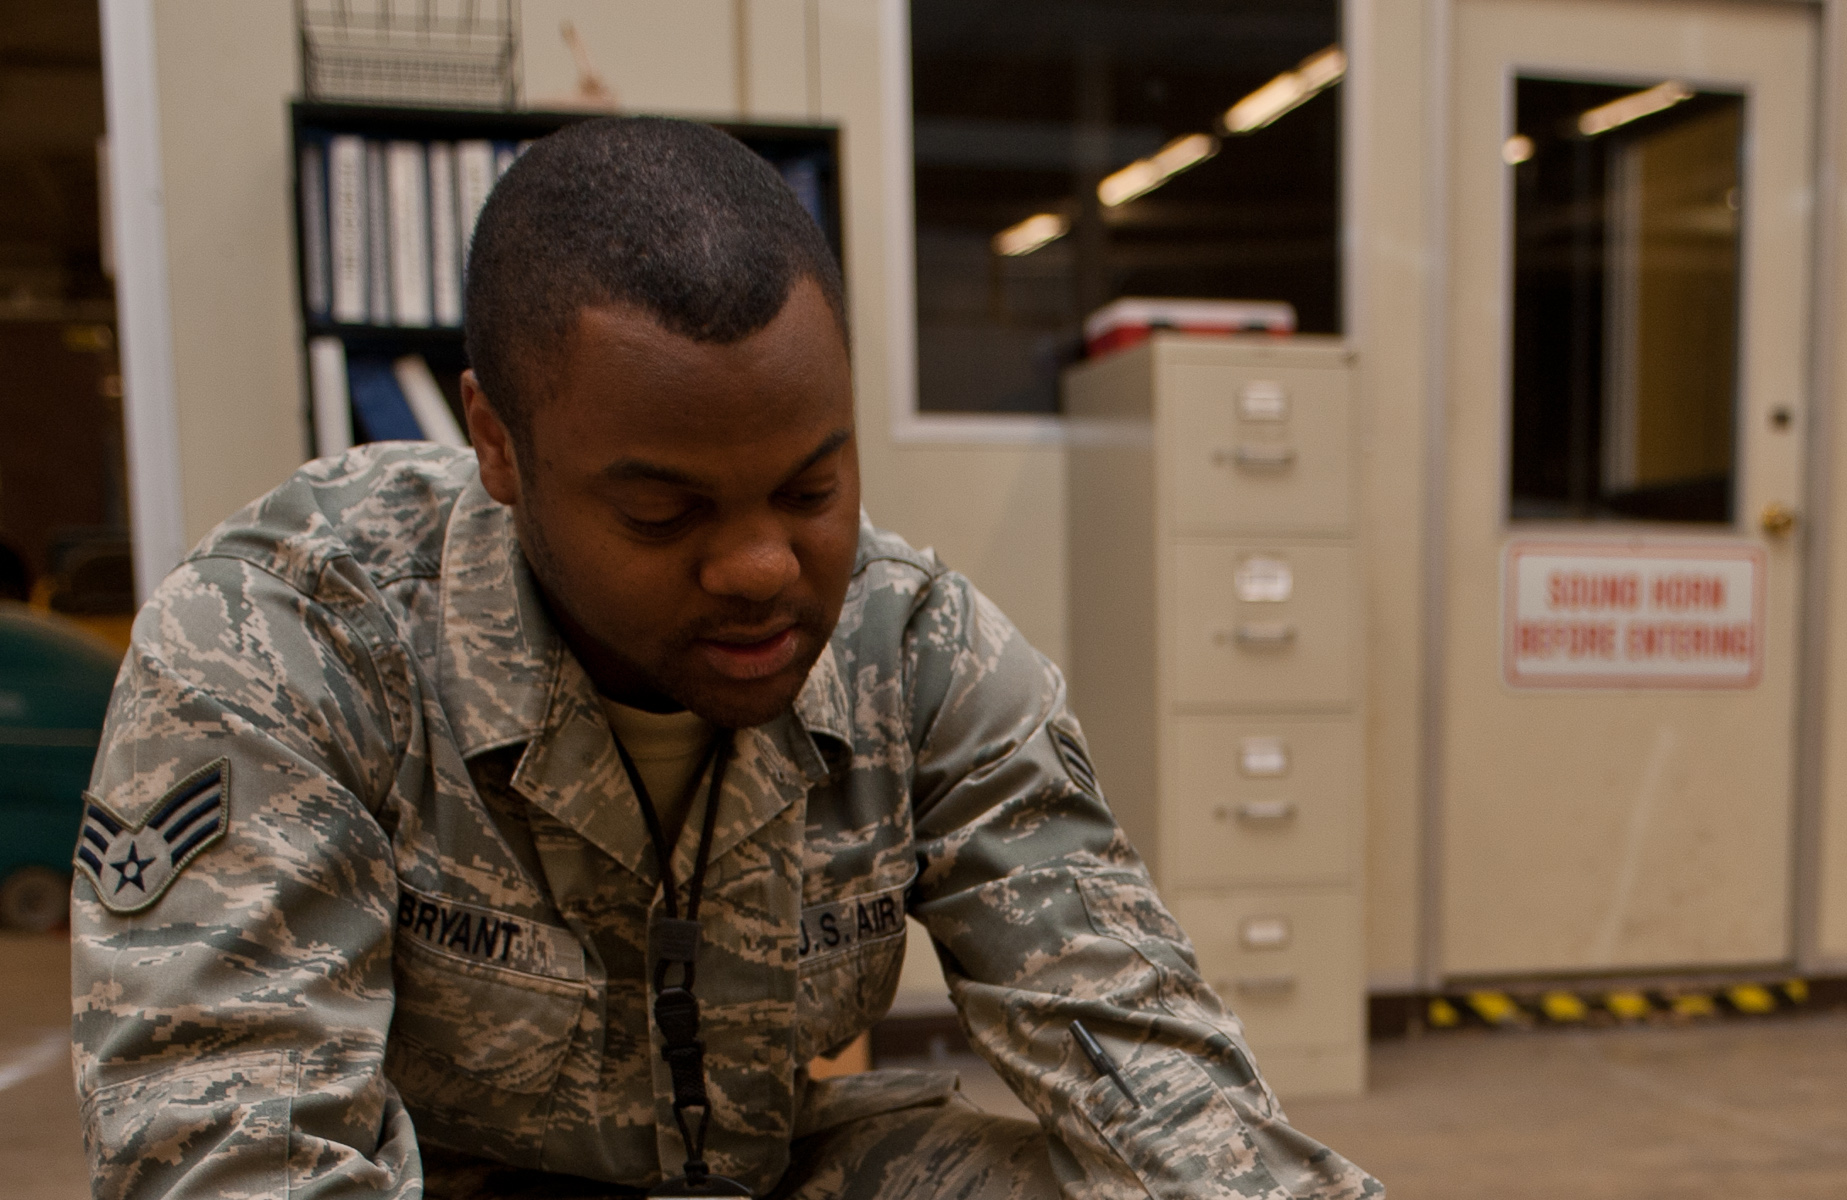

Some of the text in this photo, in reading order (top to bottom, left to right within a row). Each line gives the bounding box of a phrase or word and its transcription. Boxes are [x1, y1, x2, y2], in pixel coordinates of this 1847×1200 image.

[1550, 573, 1724, 610] SOUND HORN
[1517, 621, 1749, 661] BEFORE ENTERING
[398, 890, 521, 962] BRYANT
[857, 896, 897, 937] AIR
